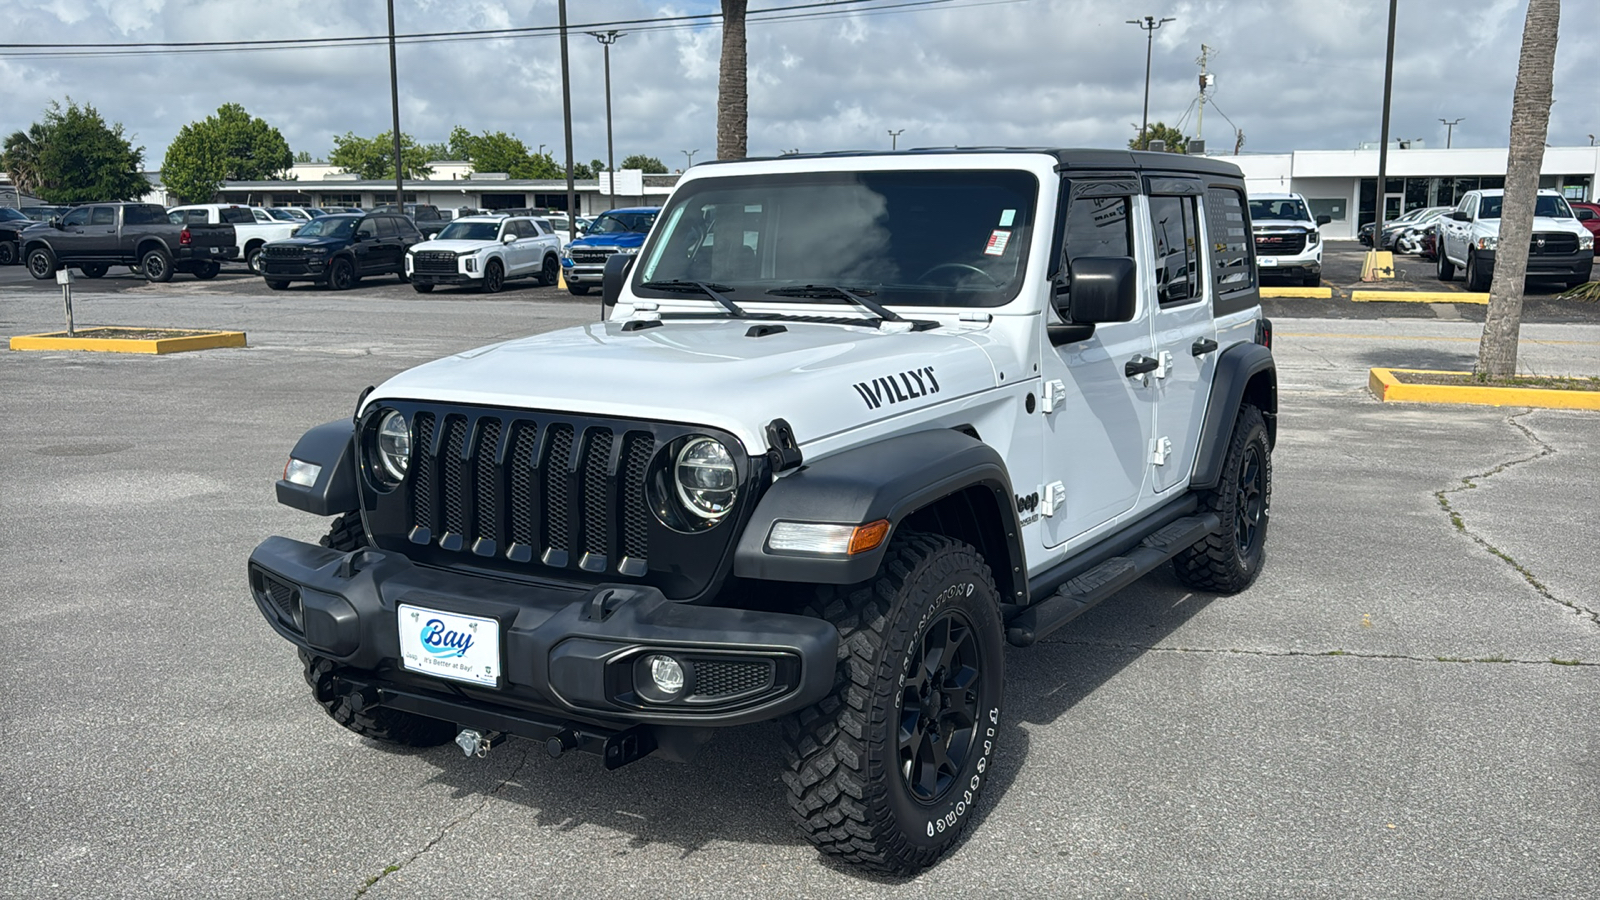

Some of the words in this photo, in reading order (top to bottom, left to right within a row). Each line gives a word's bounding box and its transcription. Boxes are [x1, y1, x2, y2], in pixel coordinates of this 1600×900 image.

[852, 366, 940, 410] WILLYS
[424, 618, 475, 658] Bay
[894, 583, 966, 709] DESTINATION
[423, 656, 432, 664] It's
[432, 658, 451, 668] Better
[452, 661, 459, 669] at
[459, 663, 473, 672] Bay!
[936, 707, 999, 833] Firestone
